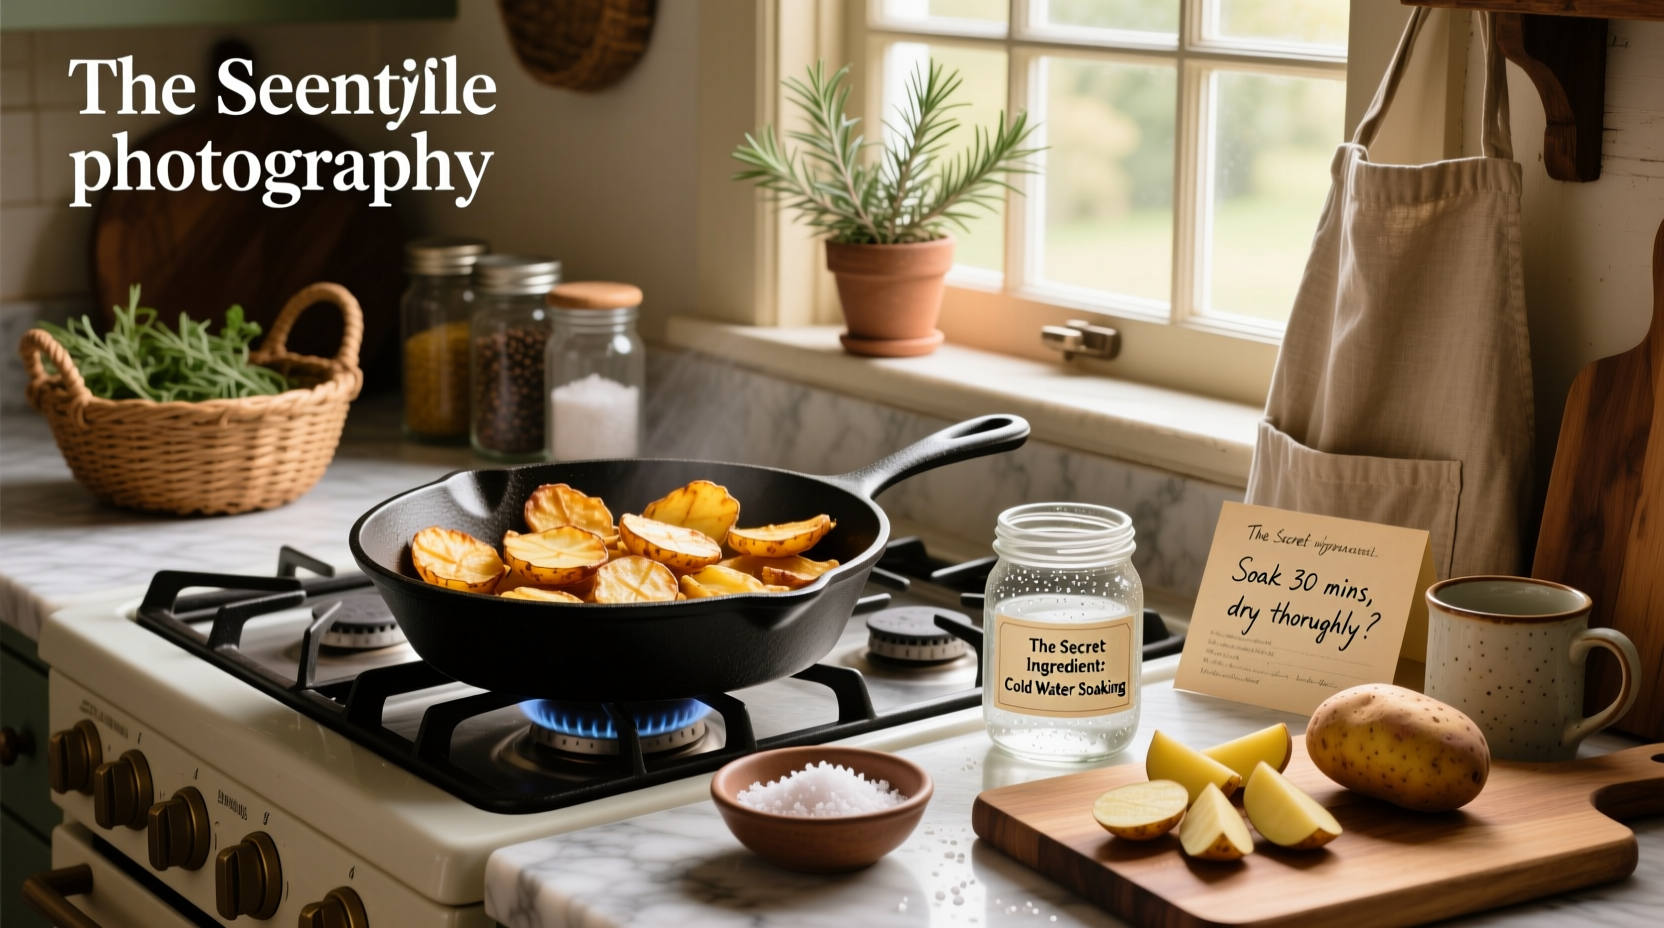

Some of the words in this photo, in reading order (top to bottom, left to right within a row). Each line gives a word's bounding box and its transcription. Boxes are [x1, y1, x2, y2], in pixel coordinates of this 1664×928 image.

[1232, 556, 1282, 586] Soak
[1289, 569, 1318, 591] 30
[1323, 579, 1373, 607] mins,
[1227, 595, 1260, 635] dry
[1029, 638, 1056, 653] The
[1060, 639, 1106, 653] Secret
[1027, 657, 1105, 676] Ingredient:
[1005, 677, 1032, 694] Cold
[1036, 681, 1075, 696] Water
